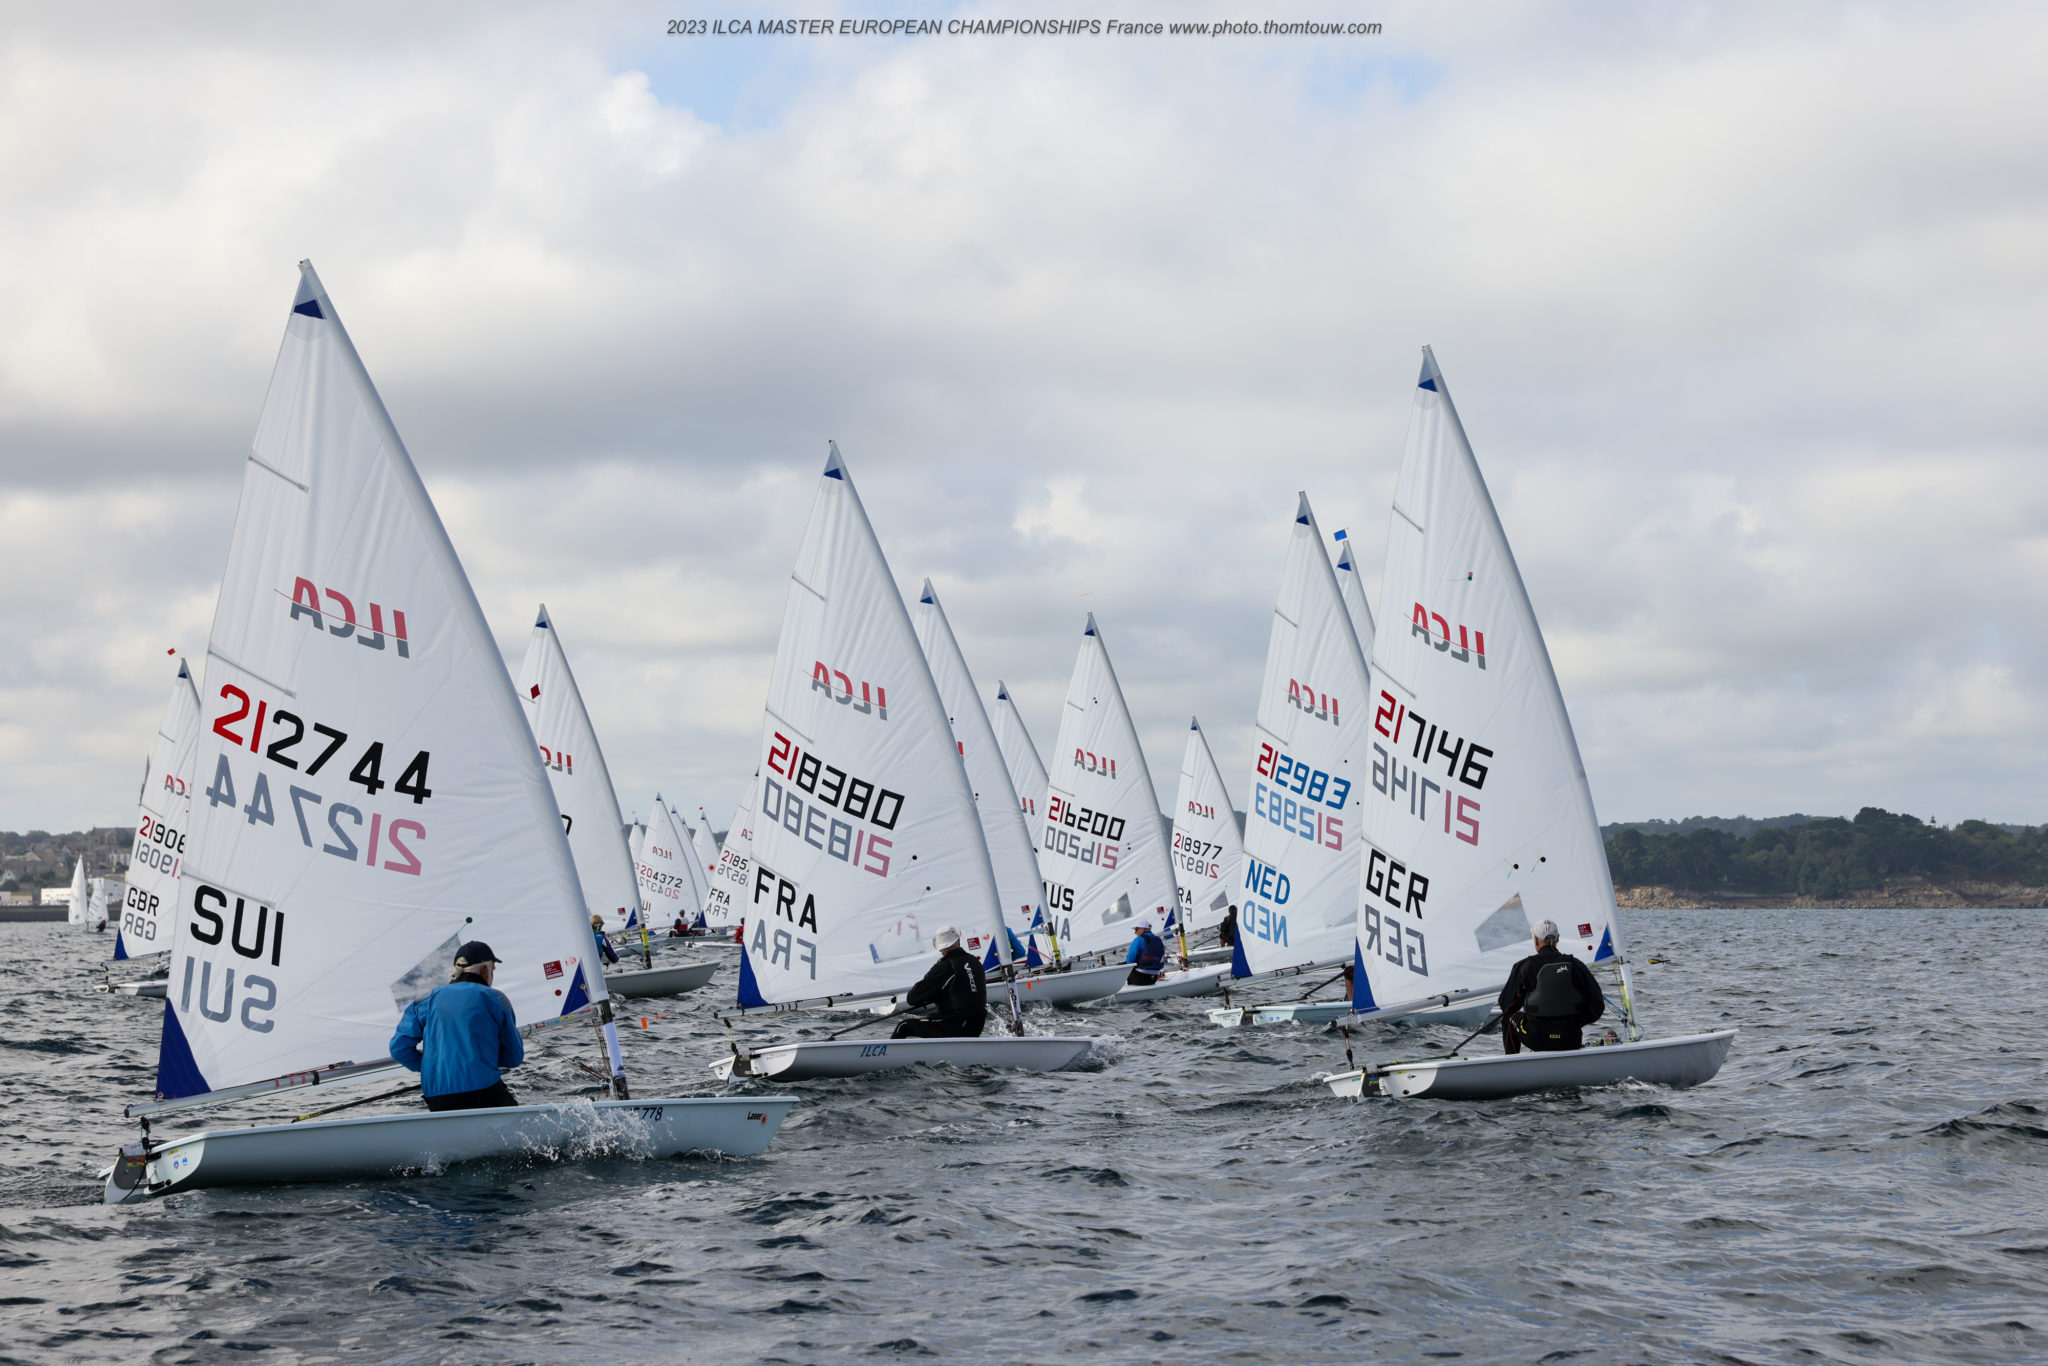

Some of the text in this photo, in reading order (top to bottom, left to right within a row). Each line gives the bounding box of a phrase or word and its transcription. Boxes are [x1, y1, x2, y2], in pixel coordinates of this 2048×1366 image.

[212, 684, 432, 804] 212744
[1374, 689, 1494, 790] 217146
[767, 731, 906, 831] 218380
[1257, 742, 1351, 810] 212983
[139, 815, 185, 854] 21906
[1048, 796, 1126, 841] 216200
[721, 850, 749, 873] 2185
[1174, 832, 1223, 860] 218977
[640, 864, 683, 889] 204372
[1178, 887, 1193, 904] RA
[1245, 859, 1291, 905] NED
[1365, 848, 1429, 919] GER
[127, 887, 159, 917] GBR
[709, 888, 731, 906] FRA
[753, 866, 817, 934] FRA
[190, 884, 284, 967] SUI
[860, 1045, 888, 1058] ILCA
[642, 1106, 664, 1122] 778
[747, 1111, 763, 1121] Laser
